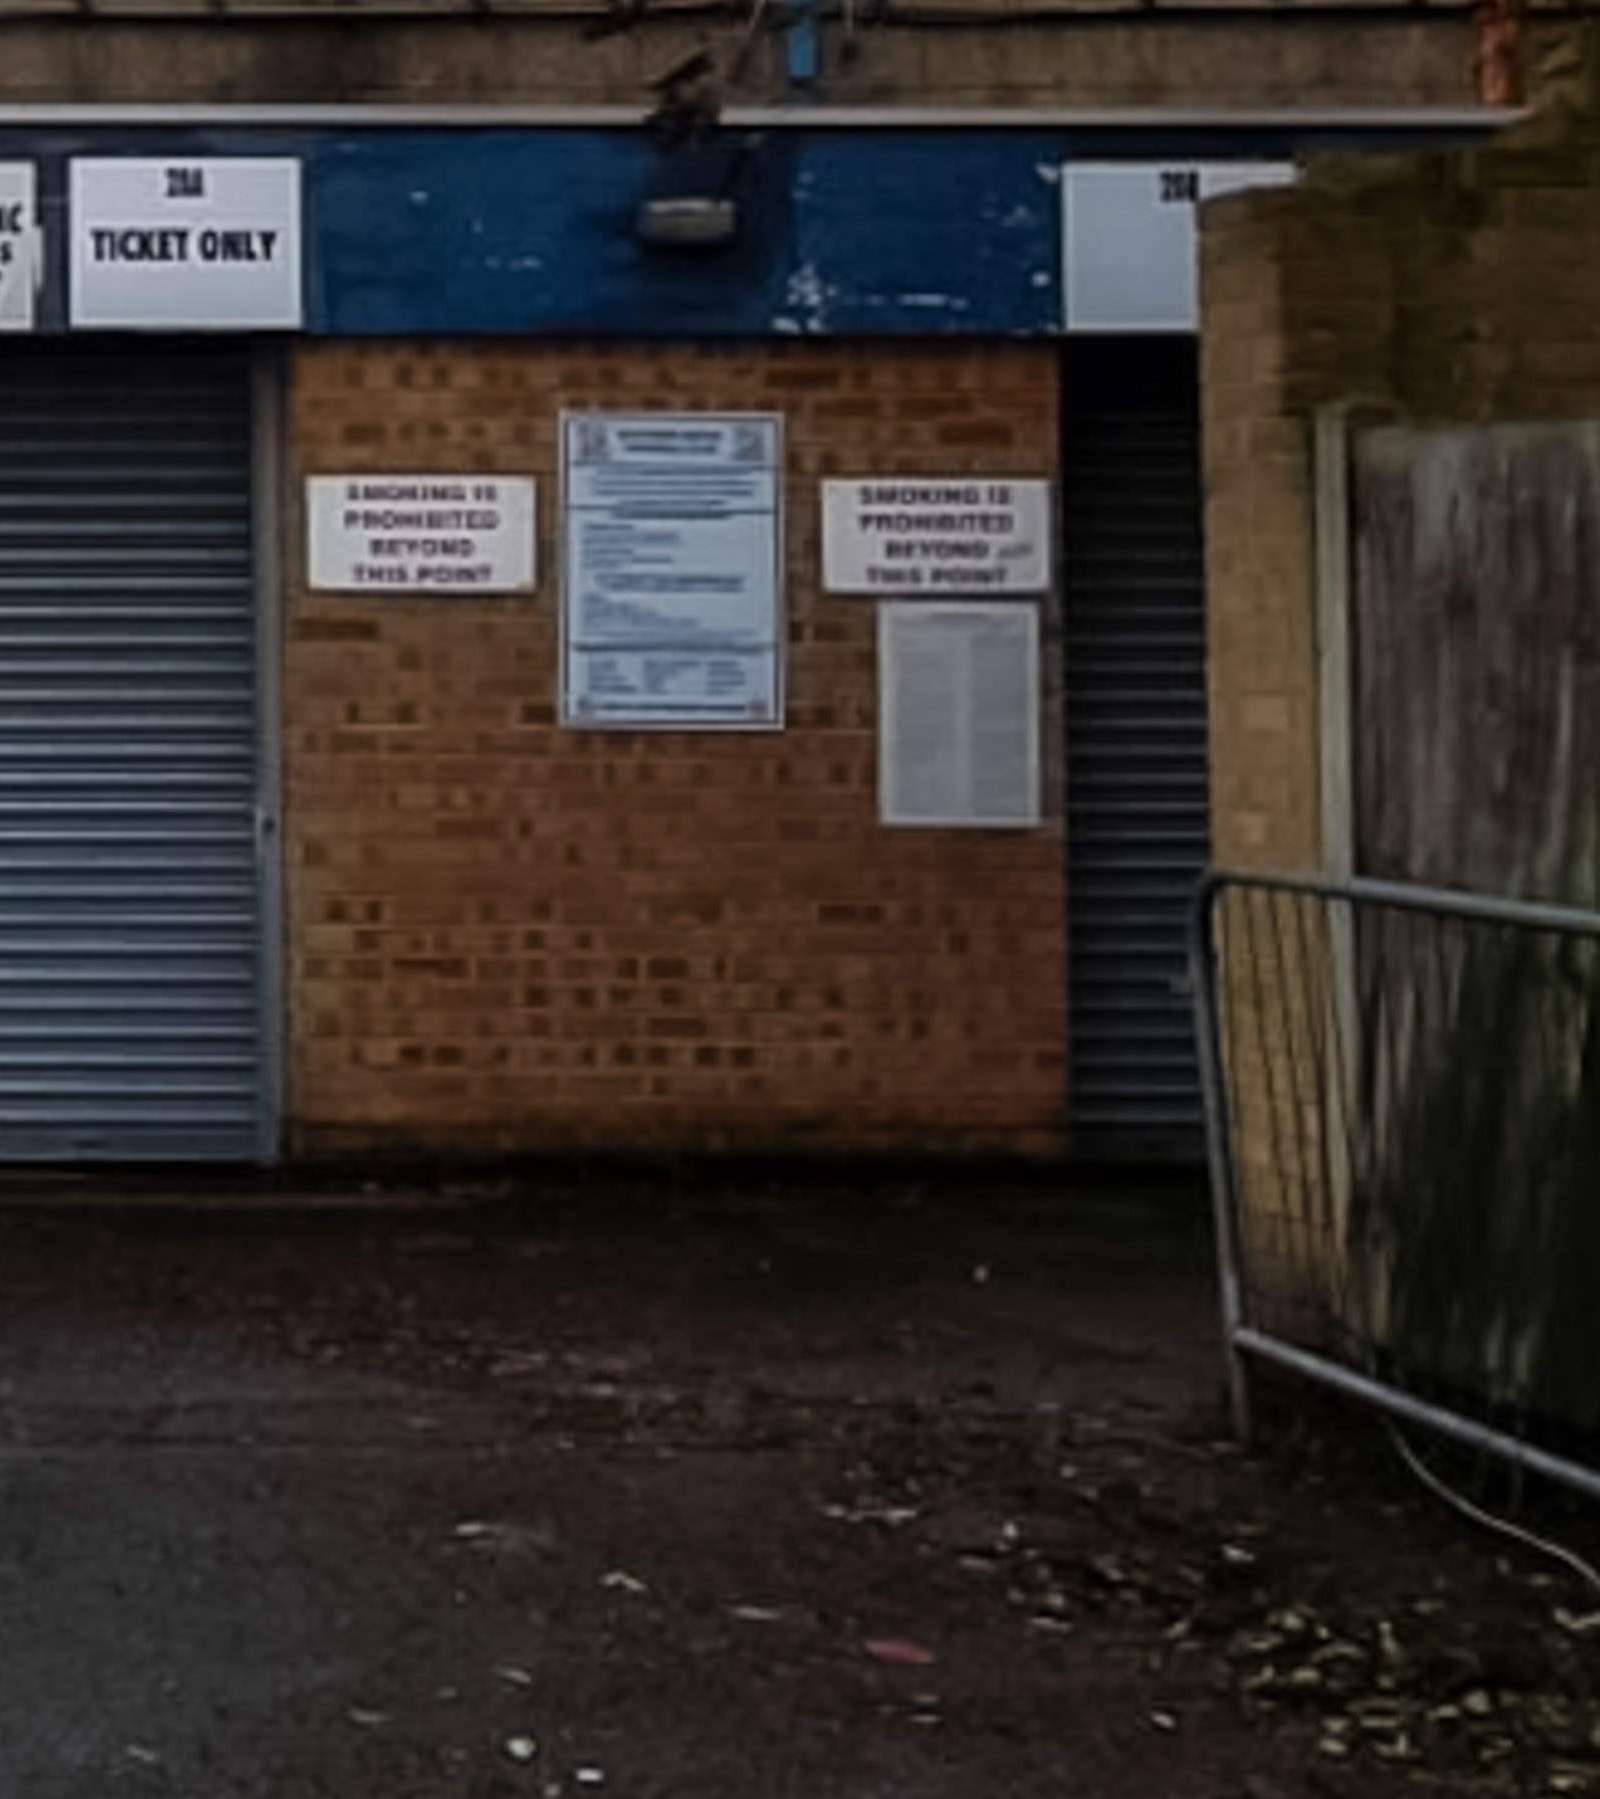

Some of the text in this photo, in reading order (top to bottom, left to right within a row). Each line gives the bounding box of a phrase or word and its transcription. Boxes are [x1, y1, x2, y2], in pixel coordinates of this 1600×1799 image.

[89, 228, 278, 262] TICKET ONLY
[346, 483, 467, 502] SMOKING
[858, 485, 980, 505] SMOKING
[369, 538, 475, 558] BEYOND
[885, 540, 990, 560] BEYOND
[352, 564, 492, 583] THIS POINT
[866, 566, 1008, 584] THIS POINT
